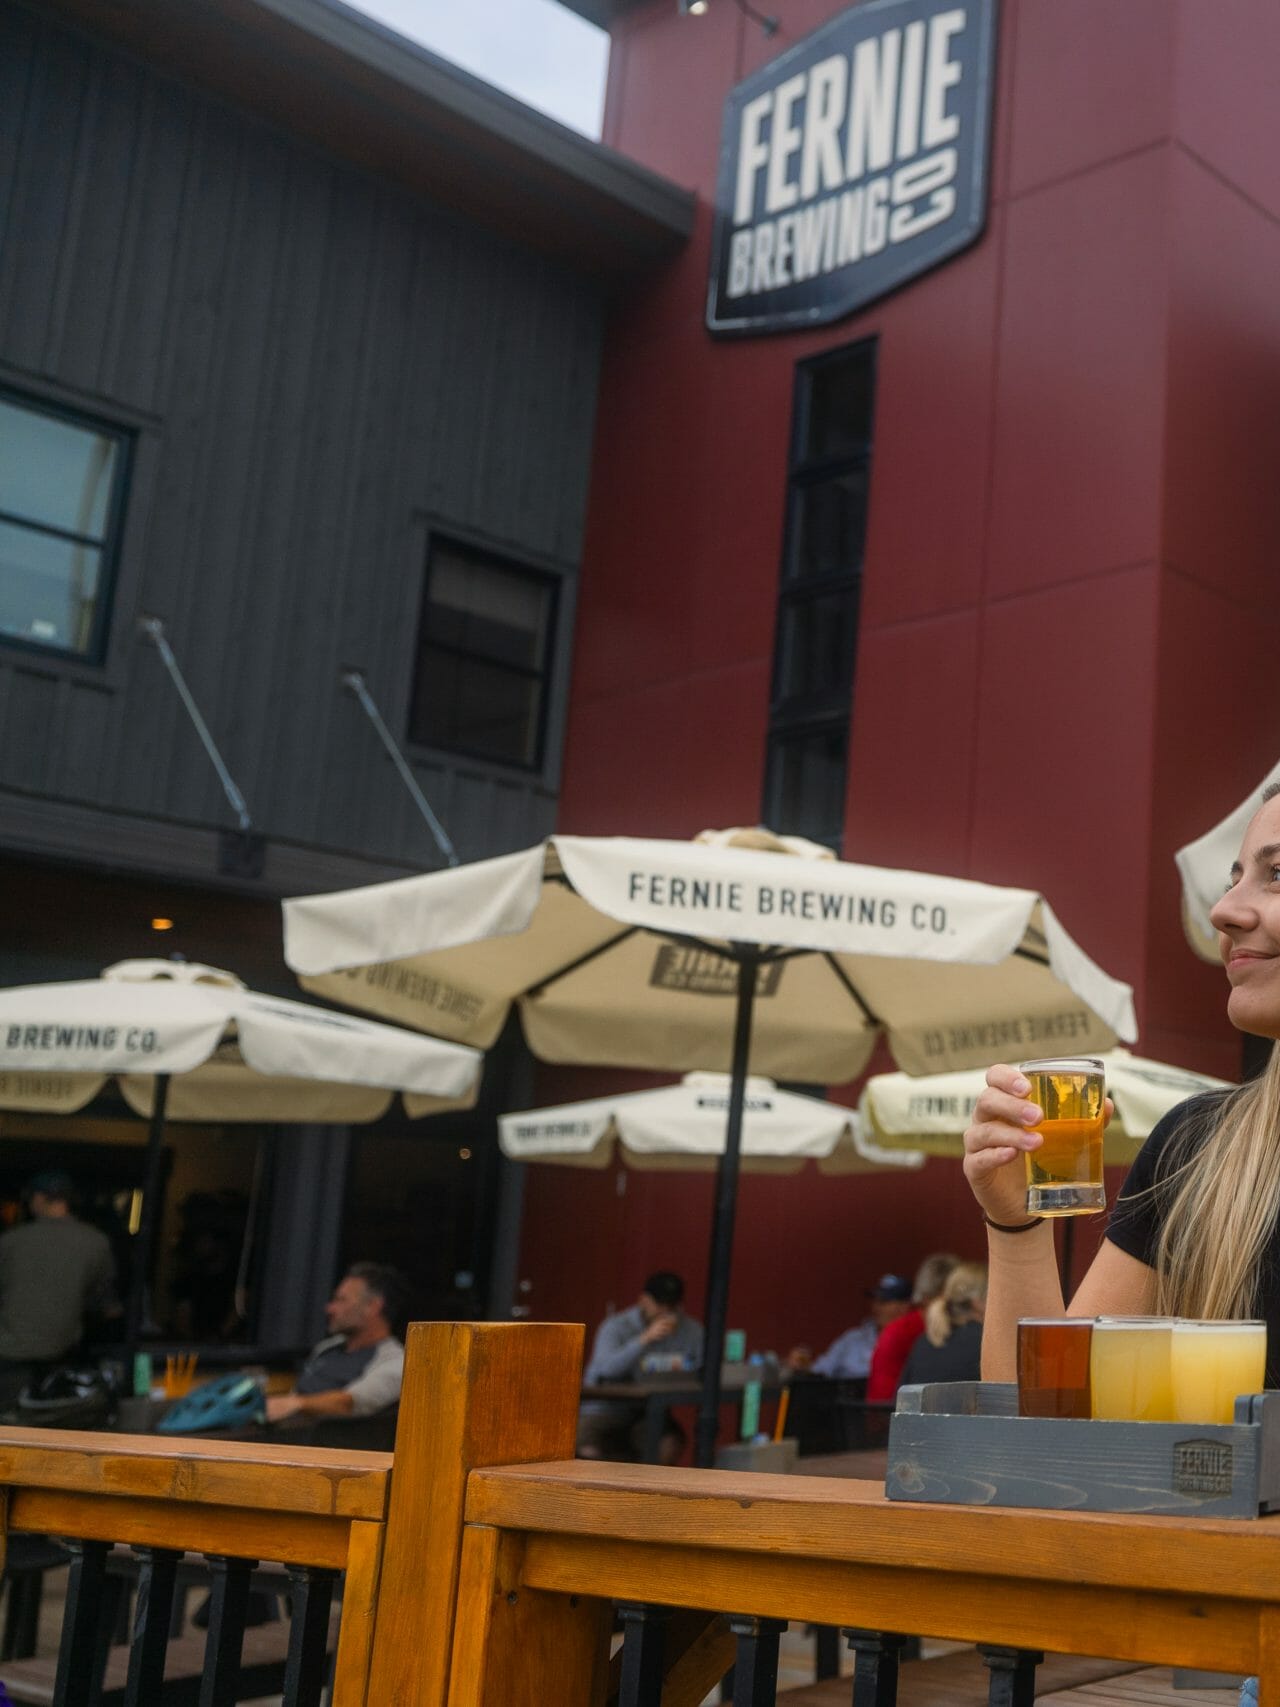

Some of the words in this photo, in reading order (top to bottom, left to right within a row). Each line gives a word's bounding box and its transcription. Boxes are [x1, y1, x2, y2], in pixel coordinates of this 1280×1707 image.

[733, 8, 966, 227] FERNIE
[727, 176, 890, 299] BREWING
[628, 872, 743, 913] FERNIE
[757, 887, 897, 929] BREWING
[911, 903, 957, 936] CO.
[6, 1024, 116, 1049] BREWING
